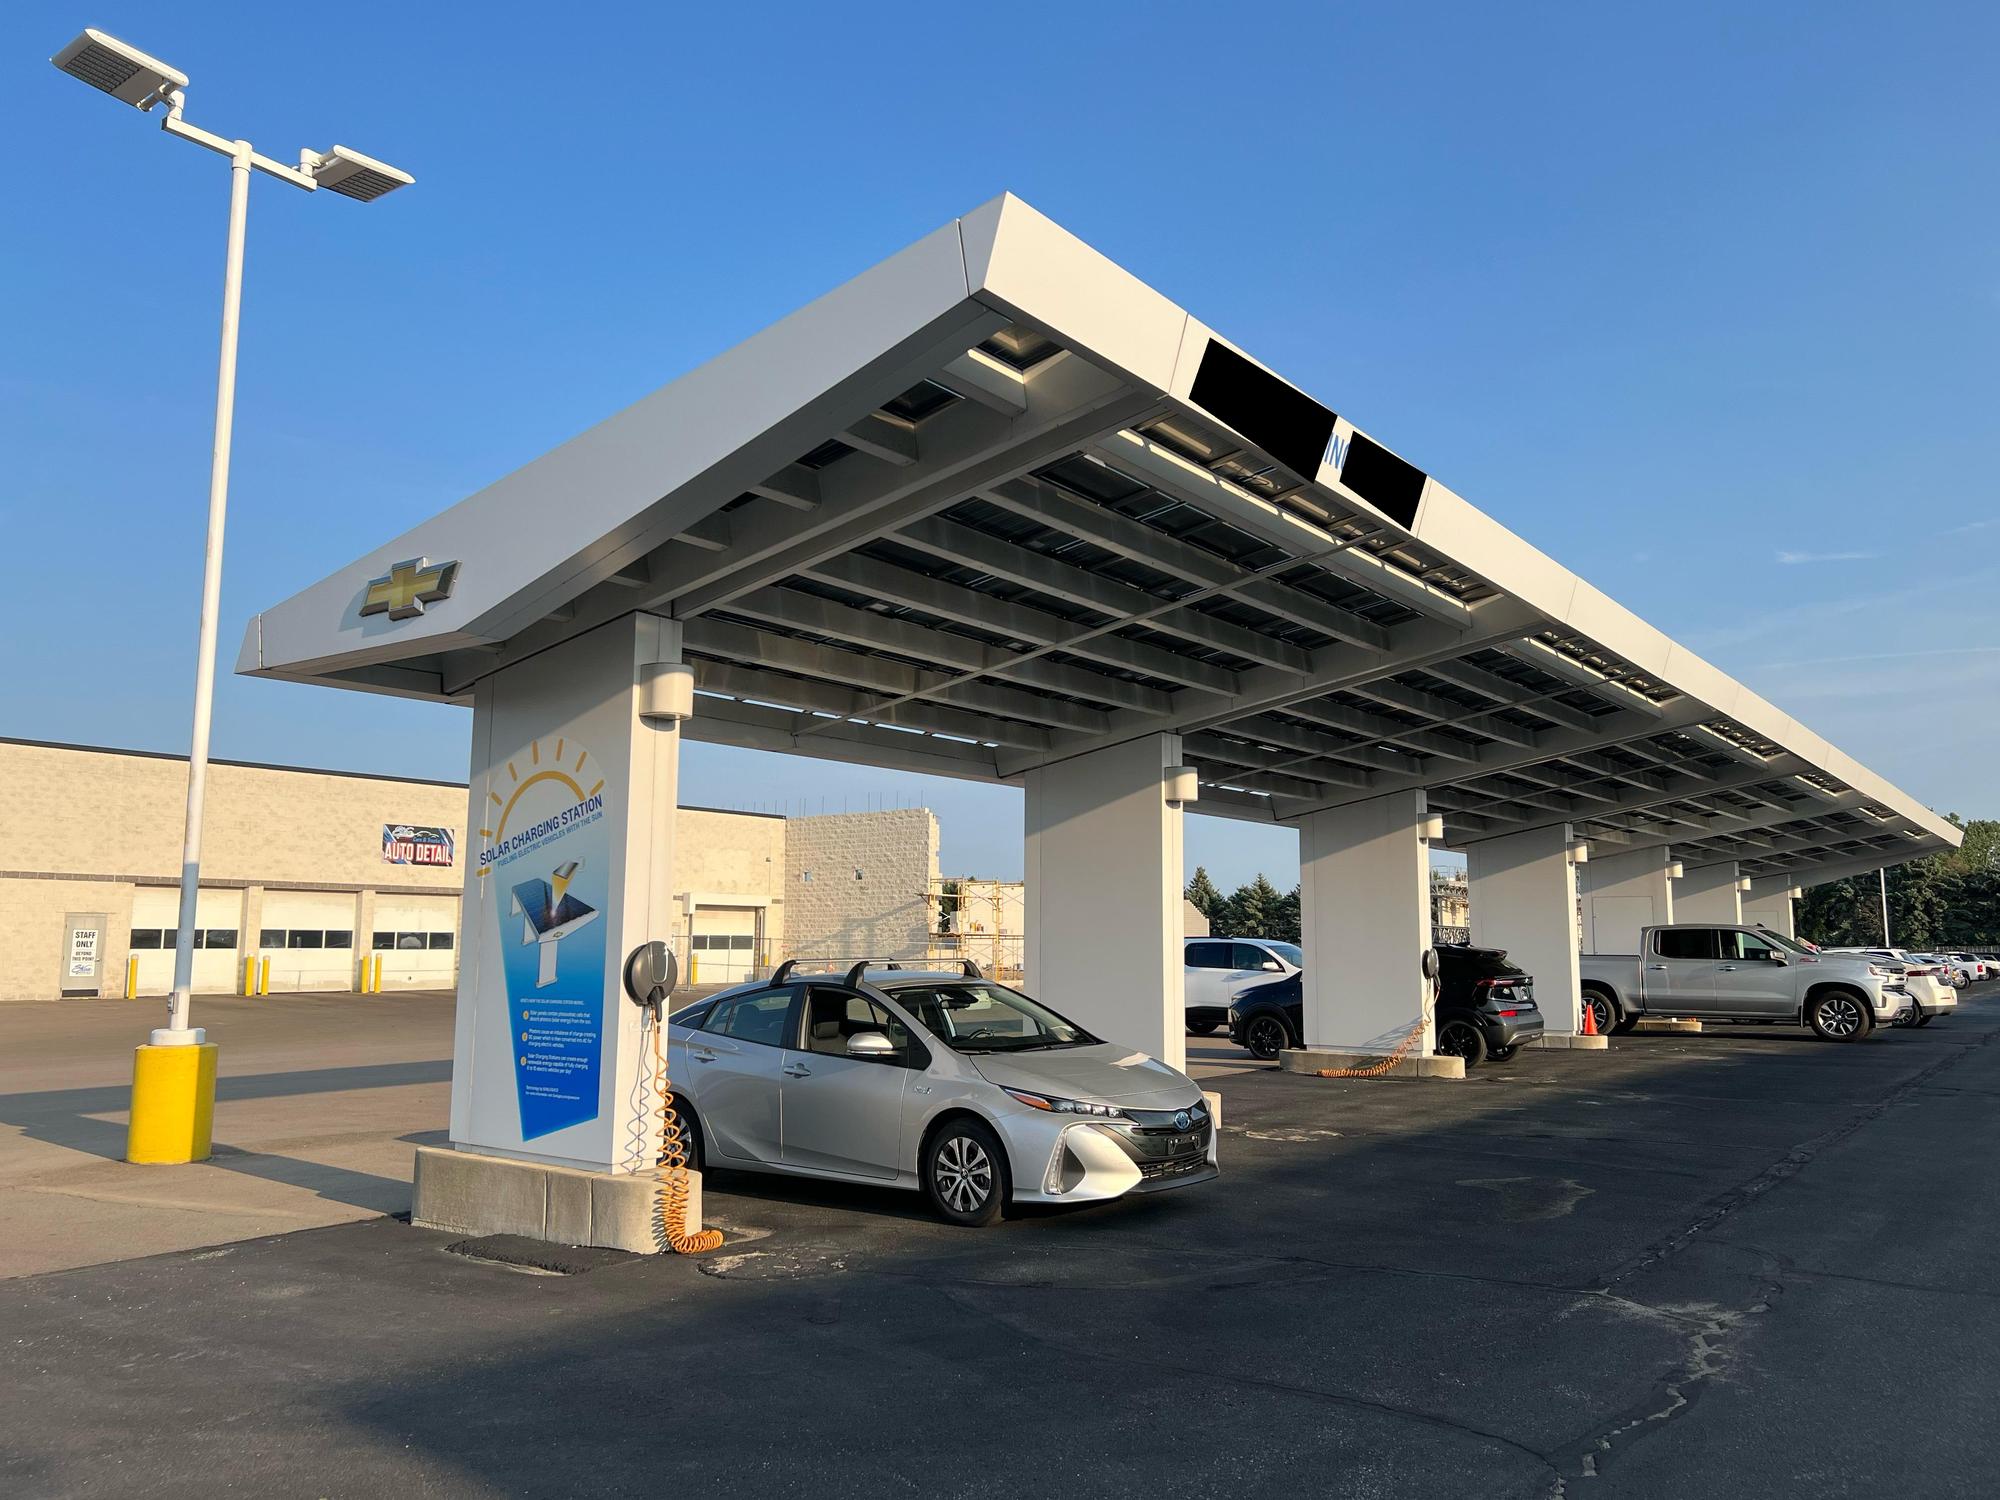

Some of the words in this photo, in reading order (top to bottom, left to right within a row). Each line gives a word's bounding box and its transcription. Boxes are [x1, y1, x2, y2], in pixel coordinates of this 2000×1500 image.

[480, 842, 511, 866] SOLAR
[511, 816, 560, 850] CHARGING
[561, 794, 603, 825] STATION
[497, 852, 518, 868] FUELING
[518, 840, 542, 857] ELECTRIC
[541, 829, 566, 847] VEHICLES
[566, 822, 581, 836] WITH
[580, 817, 591, 828] THE
[591, 811, 603, 823] SUN
[384, 842, 415, 861] AUTO
[415, 844, 452, 863] DETAIL
[75, 931, 96, 939] STAFF
[76, 940, 93, 948] ONLY
